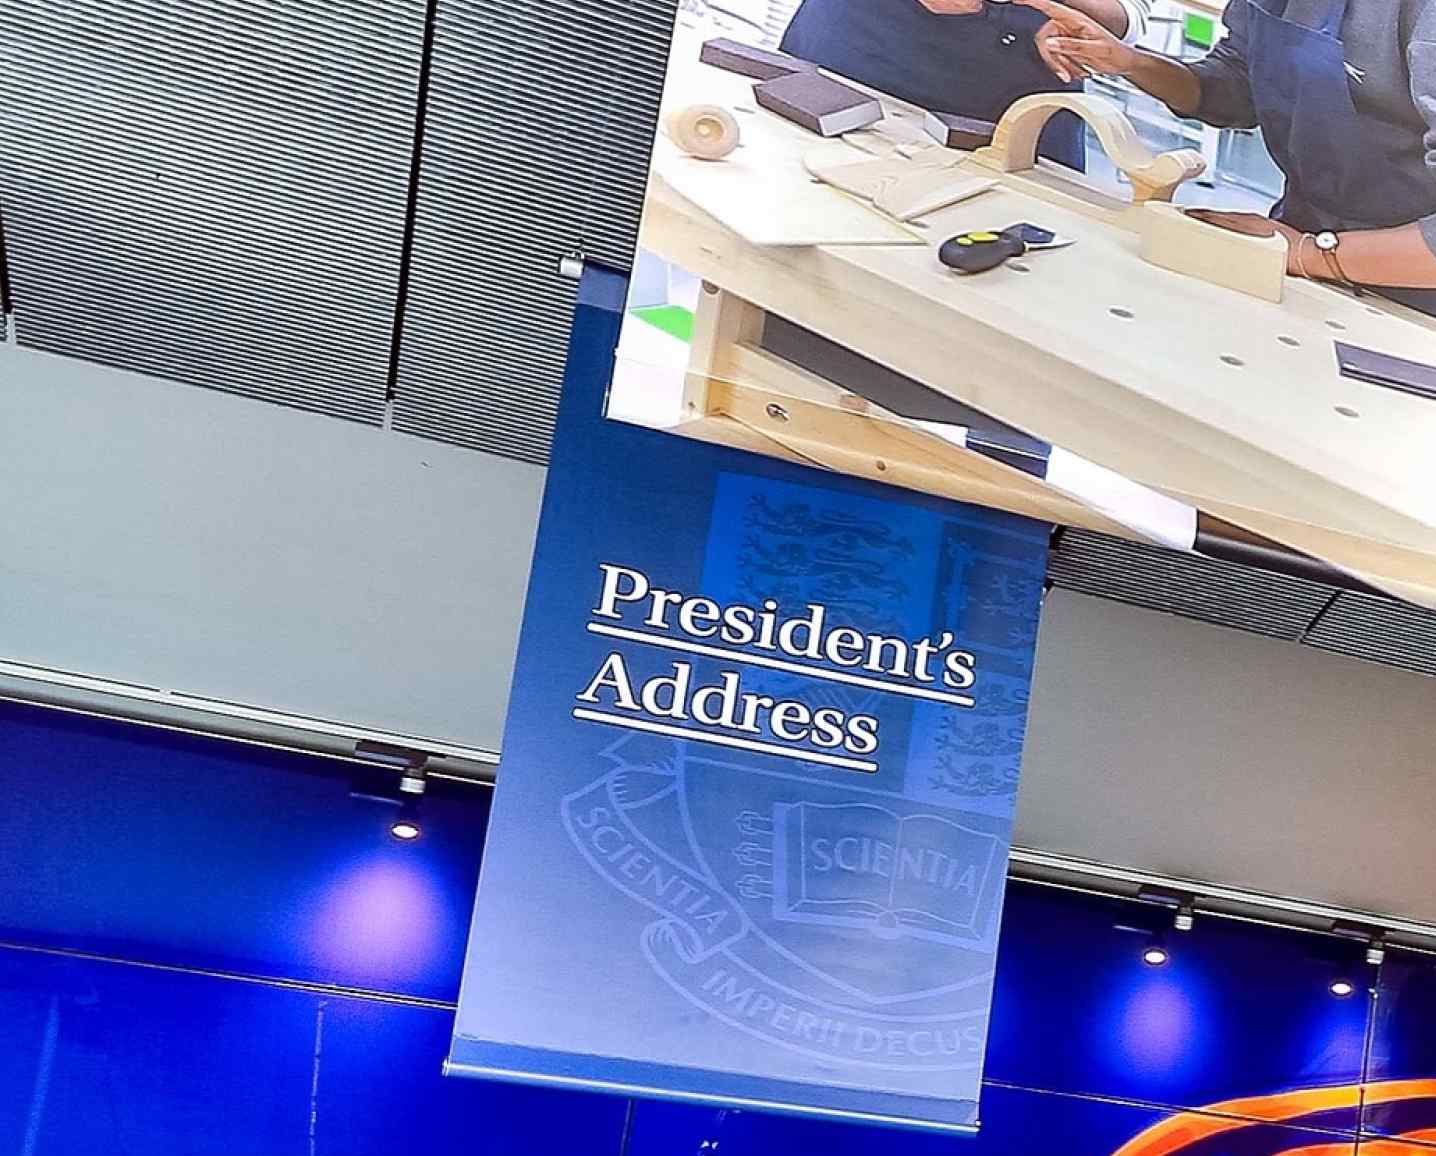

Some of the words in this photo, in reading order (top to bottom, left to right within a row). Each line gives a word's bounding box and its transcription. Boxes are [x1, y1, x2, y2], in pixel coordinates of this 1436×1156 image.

[592, 563, 977, 690] President's
[578, 653, 881, 756] Address
[577, 804, 731, 936] SCIENTIA
[811, 834, 978, 896] SCIENTIA
[702, 970, 843, 1047] IMPERII
[854, 1026, 984, 1057] DECUS
